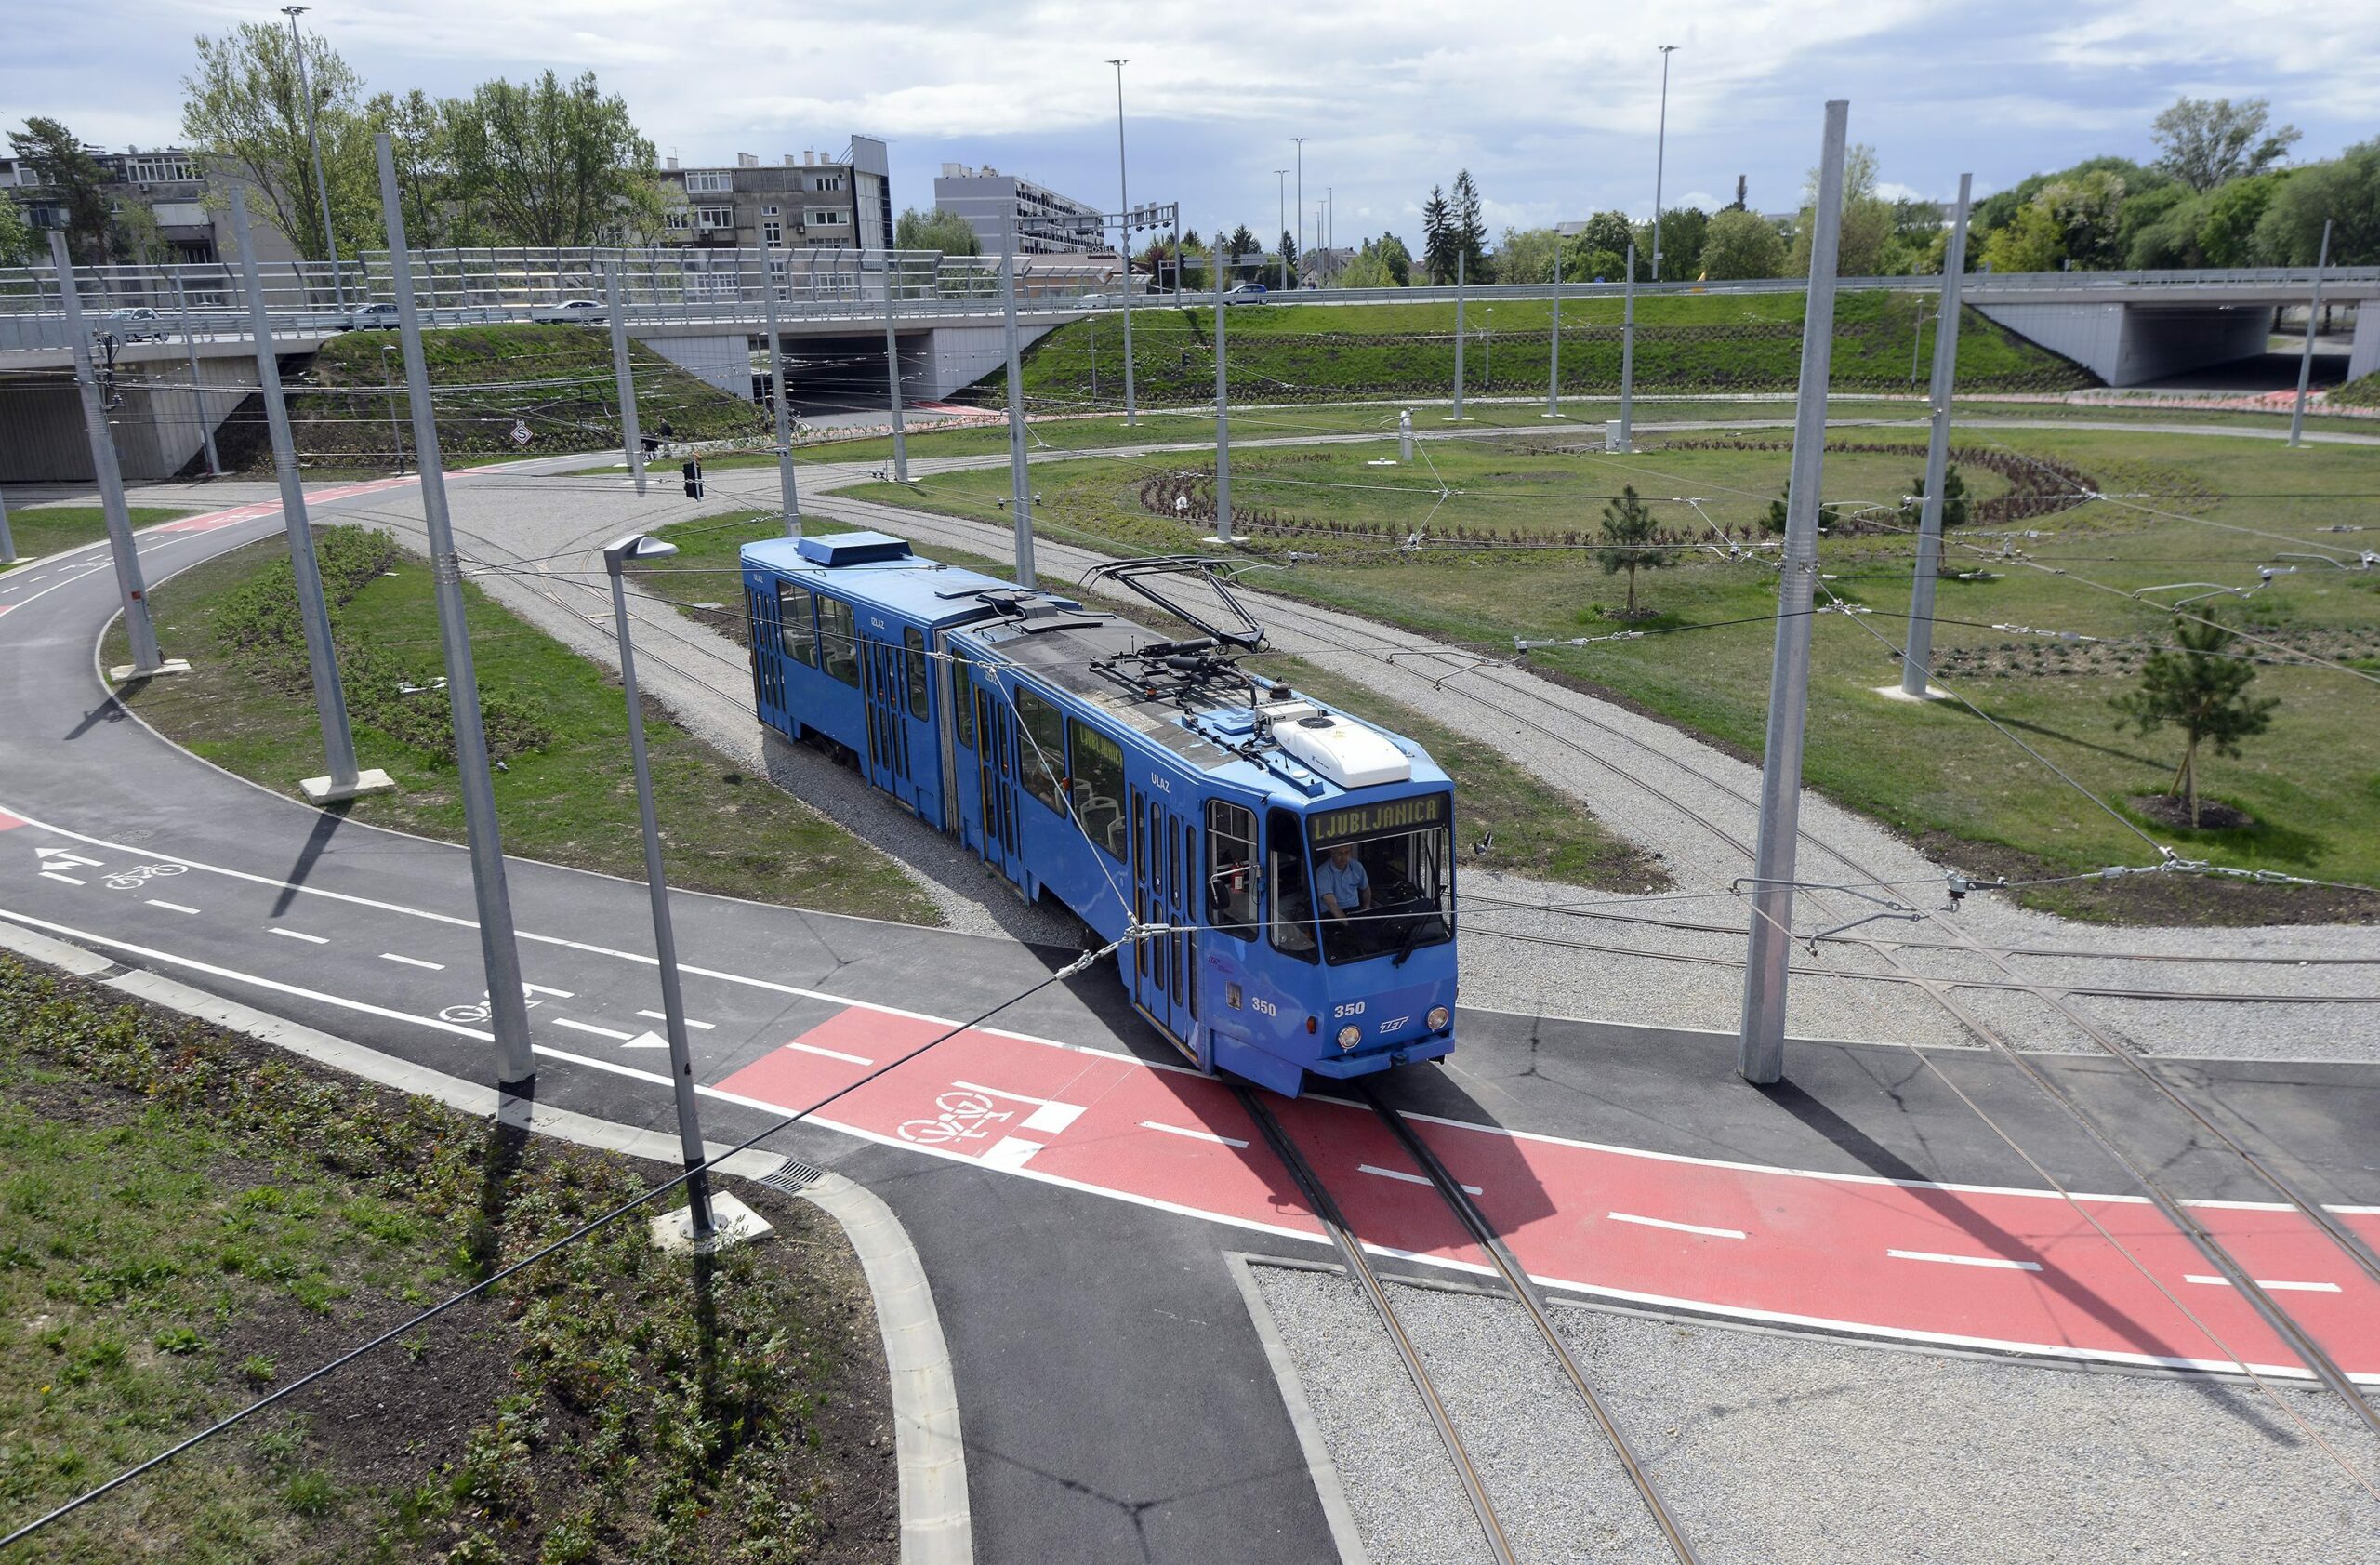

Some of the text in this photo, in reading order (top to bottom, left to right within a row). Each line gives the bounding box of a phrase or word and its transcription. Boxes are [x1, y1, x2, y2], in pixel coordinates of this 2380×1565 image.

[517, 429, 527, 439] S
[870, 617, 885, 630] IZLAZ
[1151, 772, 1170, 794] ULAZ
[1315, 799, 1437, 840] LJUBLJANICA
[1251, 996, 1276, 1017] 350
[1334, 1001, 1366, 1018] 350
[1379, 1015, 1409, 1034] ZET
